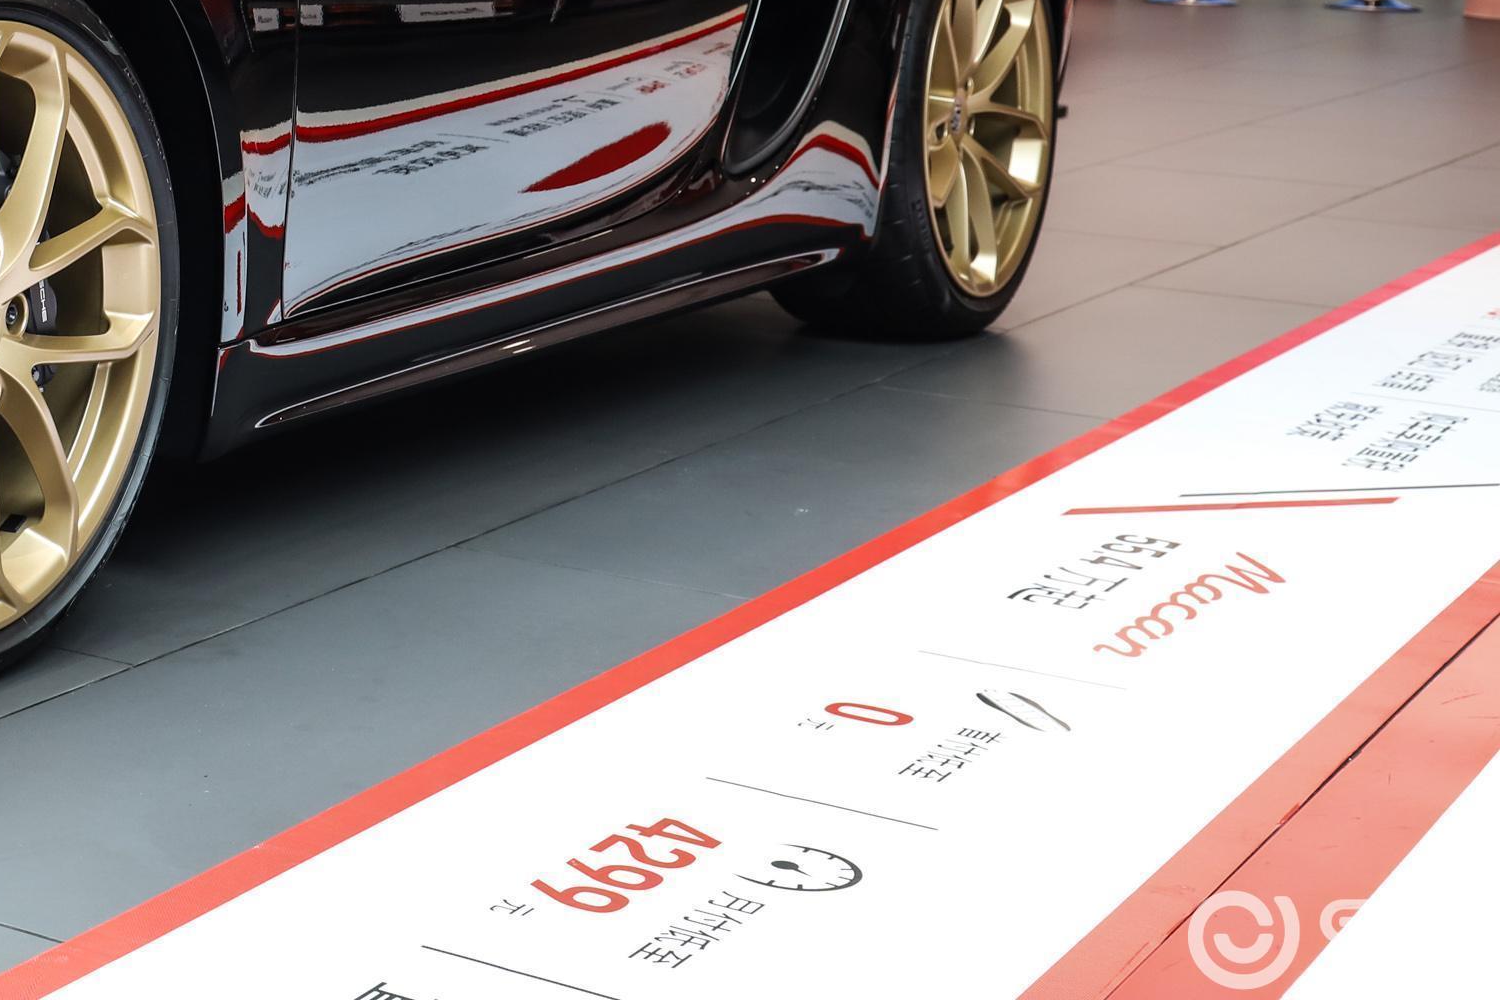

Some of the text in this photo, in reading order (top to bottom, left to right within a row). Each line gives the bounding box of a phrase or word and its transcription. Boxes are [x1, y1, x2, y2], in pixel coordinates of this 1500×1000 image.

[1092, 552, 1287, 658] Macan
[530, 817, 723, 914] 4299
[629, 890, 766, 969] 月付低至
